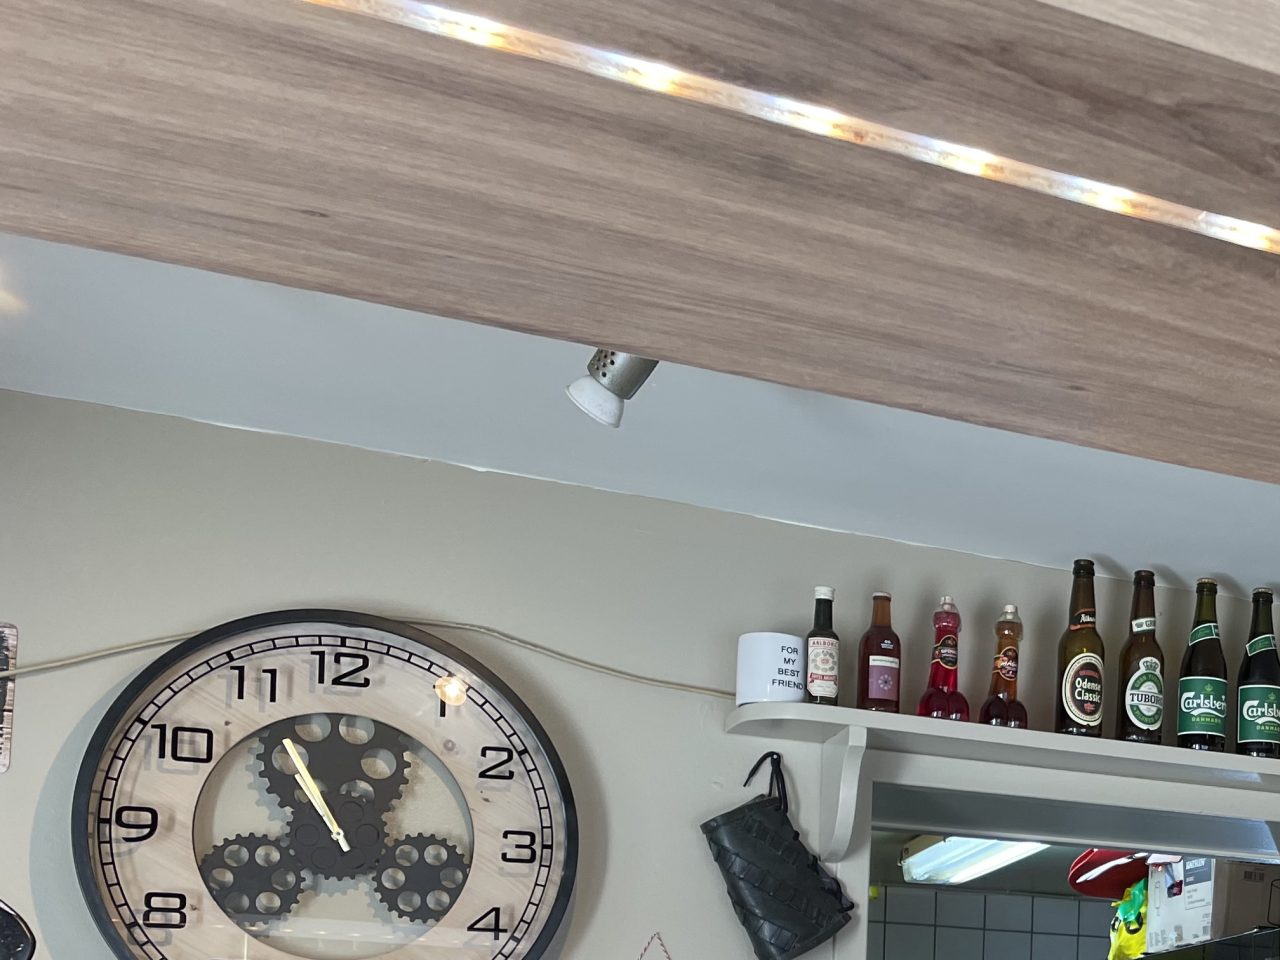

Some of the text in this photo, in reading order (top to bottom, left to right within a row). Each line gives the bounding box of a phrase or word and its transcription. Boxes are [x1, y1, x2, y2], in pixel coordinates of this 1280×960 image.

[781, 645, 799, 655] FOR
[783, 657, 797, 666] MY
[230, 665, 279, 703] 11
[311, 650, 371, 689] 12
[772, 678, 804, 690] FRIEND
[777, 667, 800, 678] BEST
[433, 683, 448, 718] 1
[151, 723, 214, 764] 10
[478, 746, 515, 781] 2
[115, 805, 159, 843] 9
[501, 831, 538, 865] 3
[143, 892, 187, 929] 8
[466, 906, 508, 941] 4
